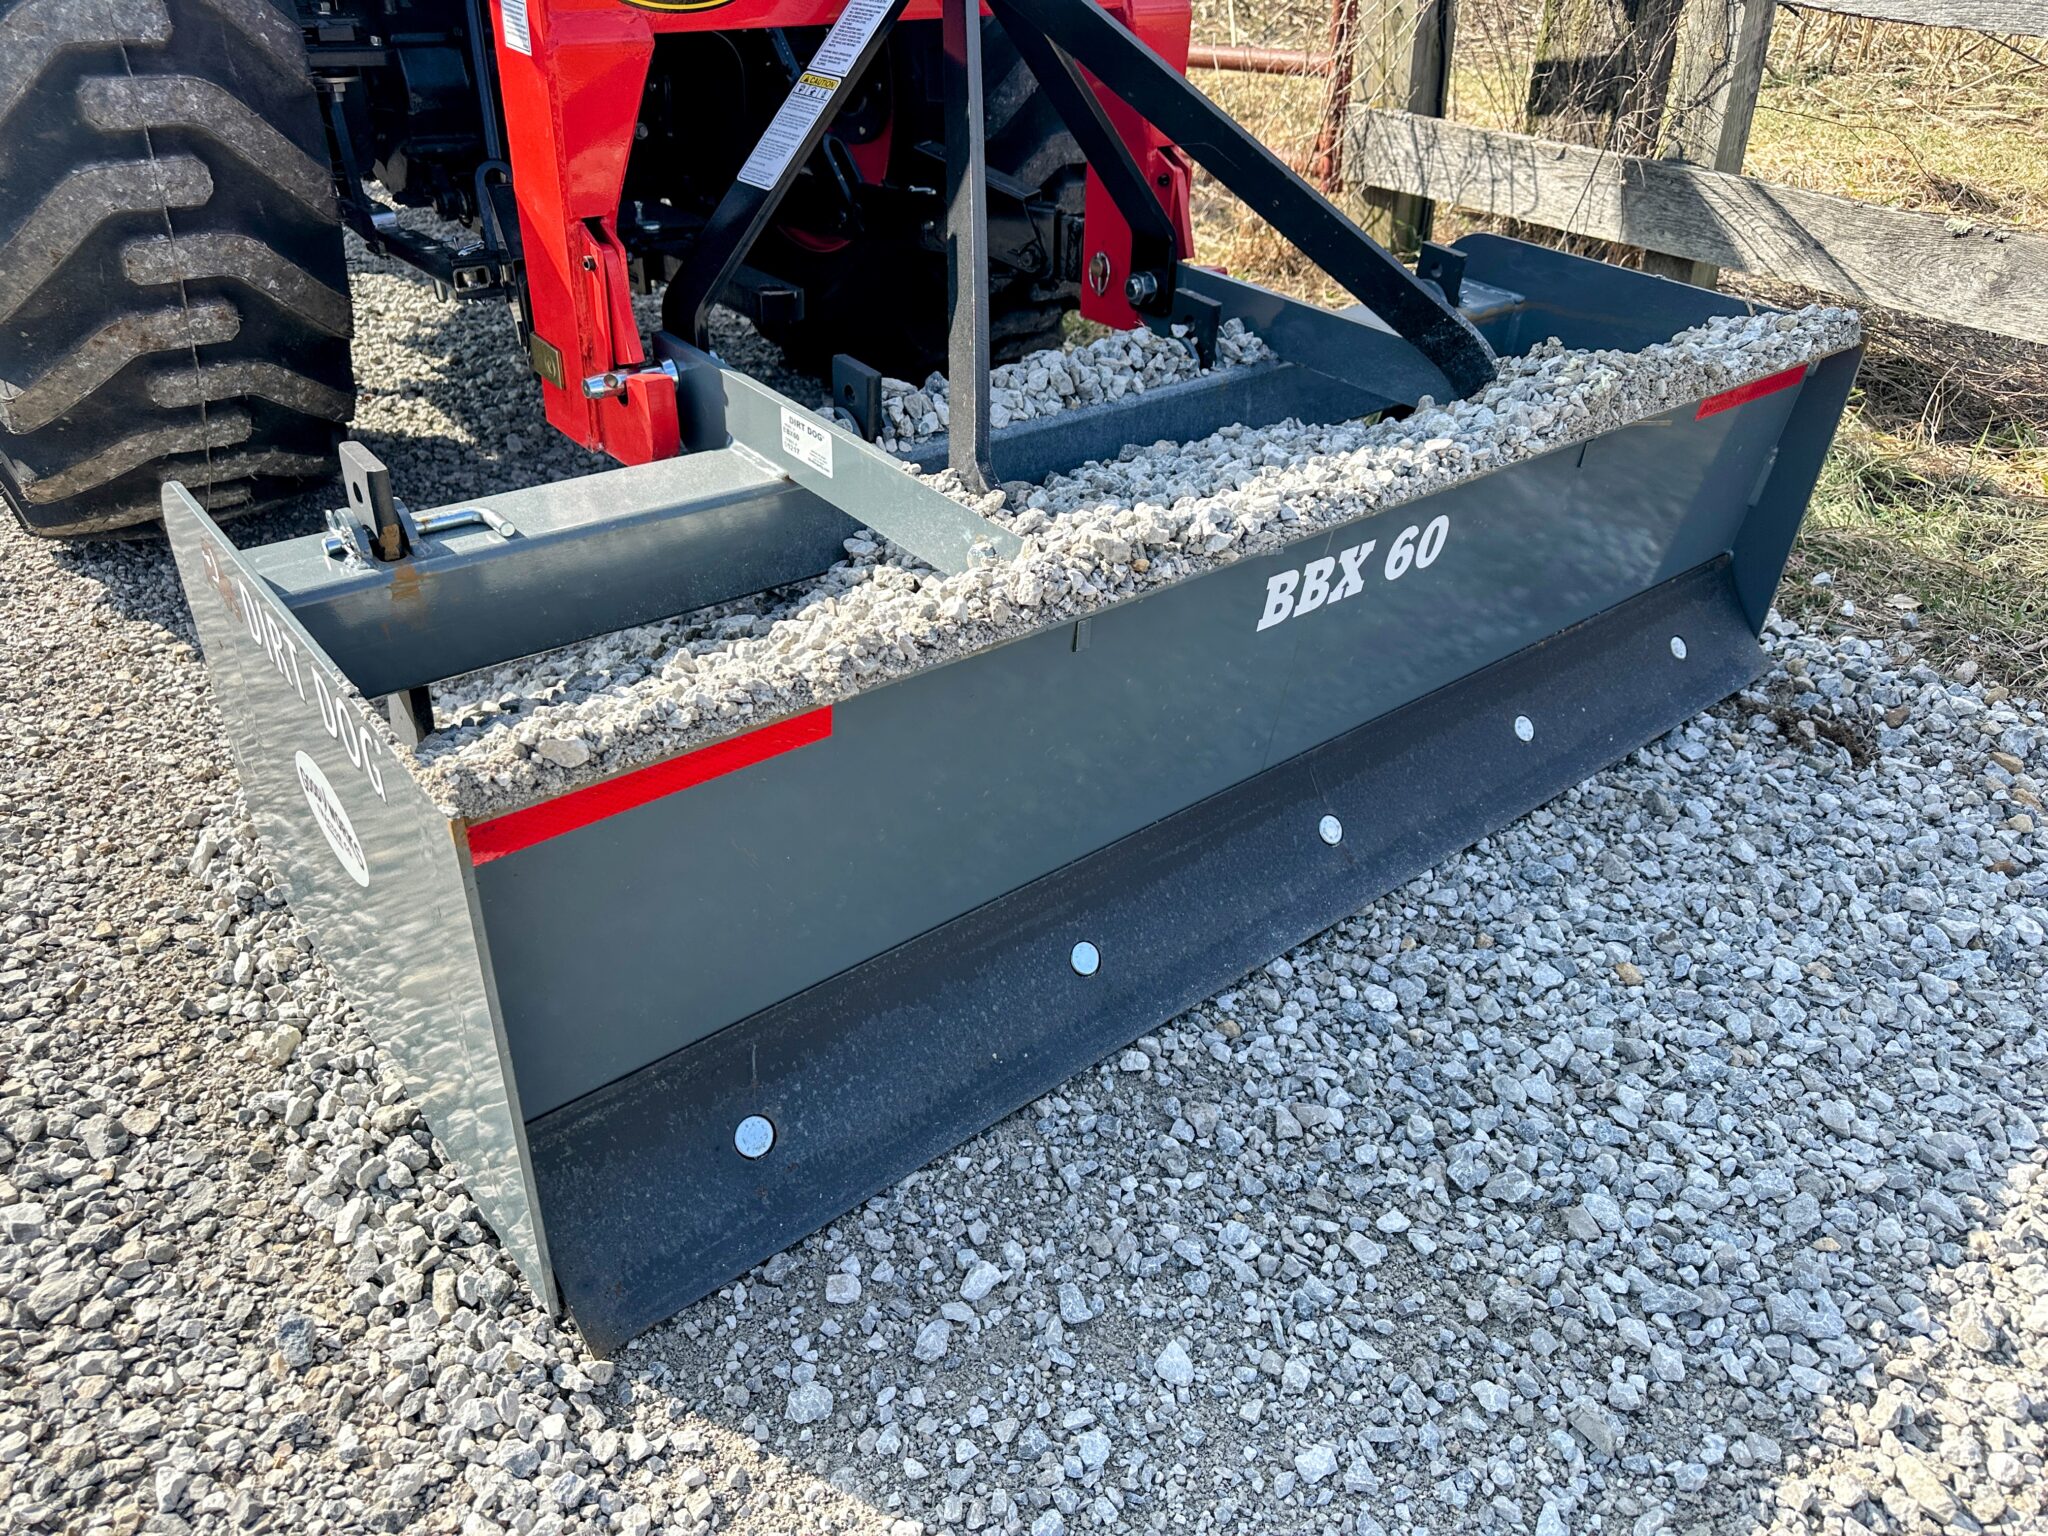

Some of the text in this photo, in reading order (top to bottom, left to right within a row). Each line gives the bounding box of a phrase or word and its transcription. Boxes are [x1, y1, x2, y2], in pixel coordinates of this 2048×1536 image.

[810, 76, 834, 88] CAUTION
[789, 416, 805, 431] DIRT
[807, 427, 823, 442] DOG
[1256, 514, 1450, 632] BBX 60
[238, 578, 387, 803] DIRT DOG
